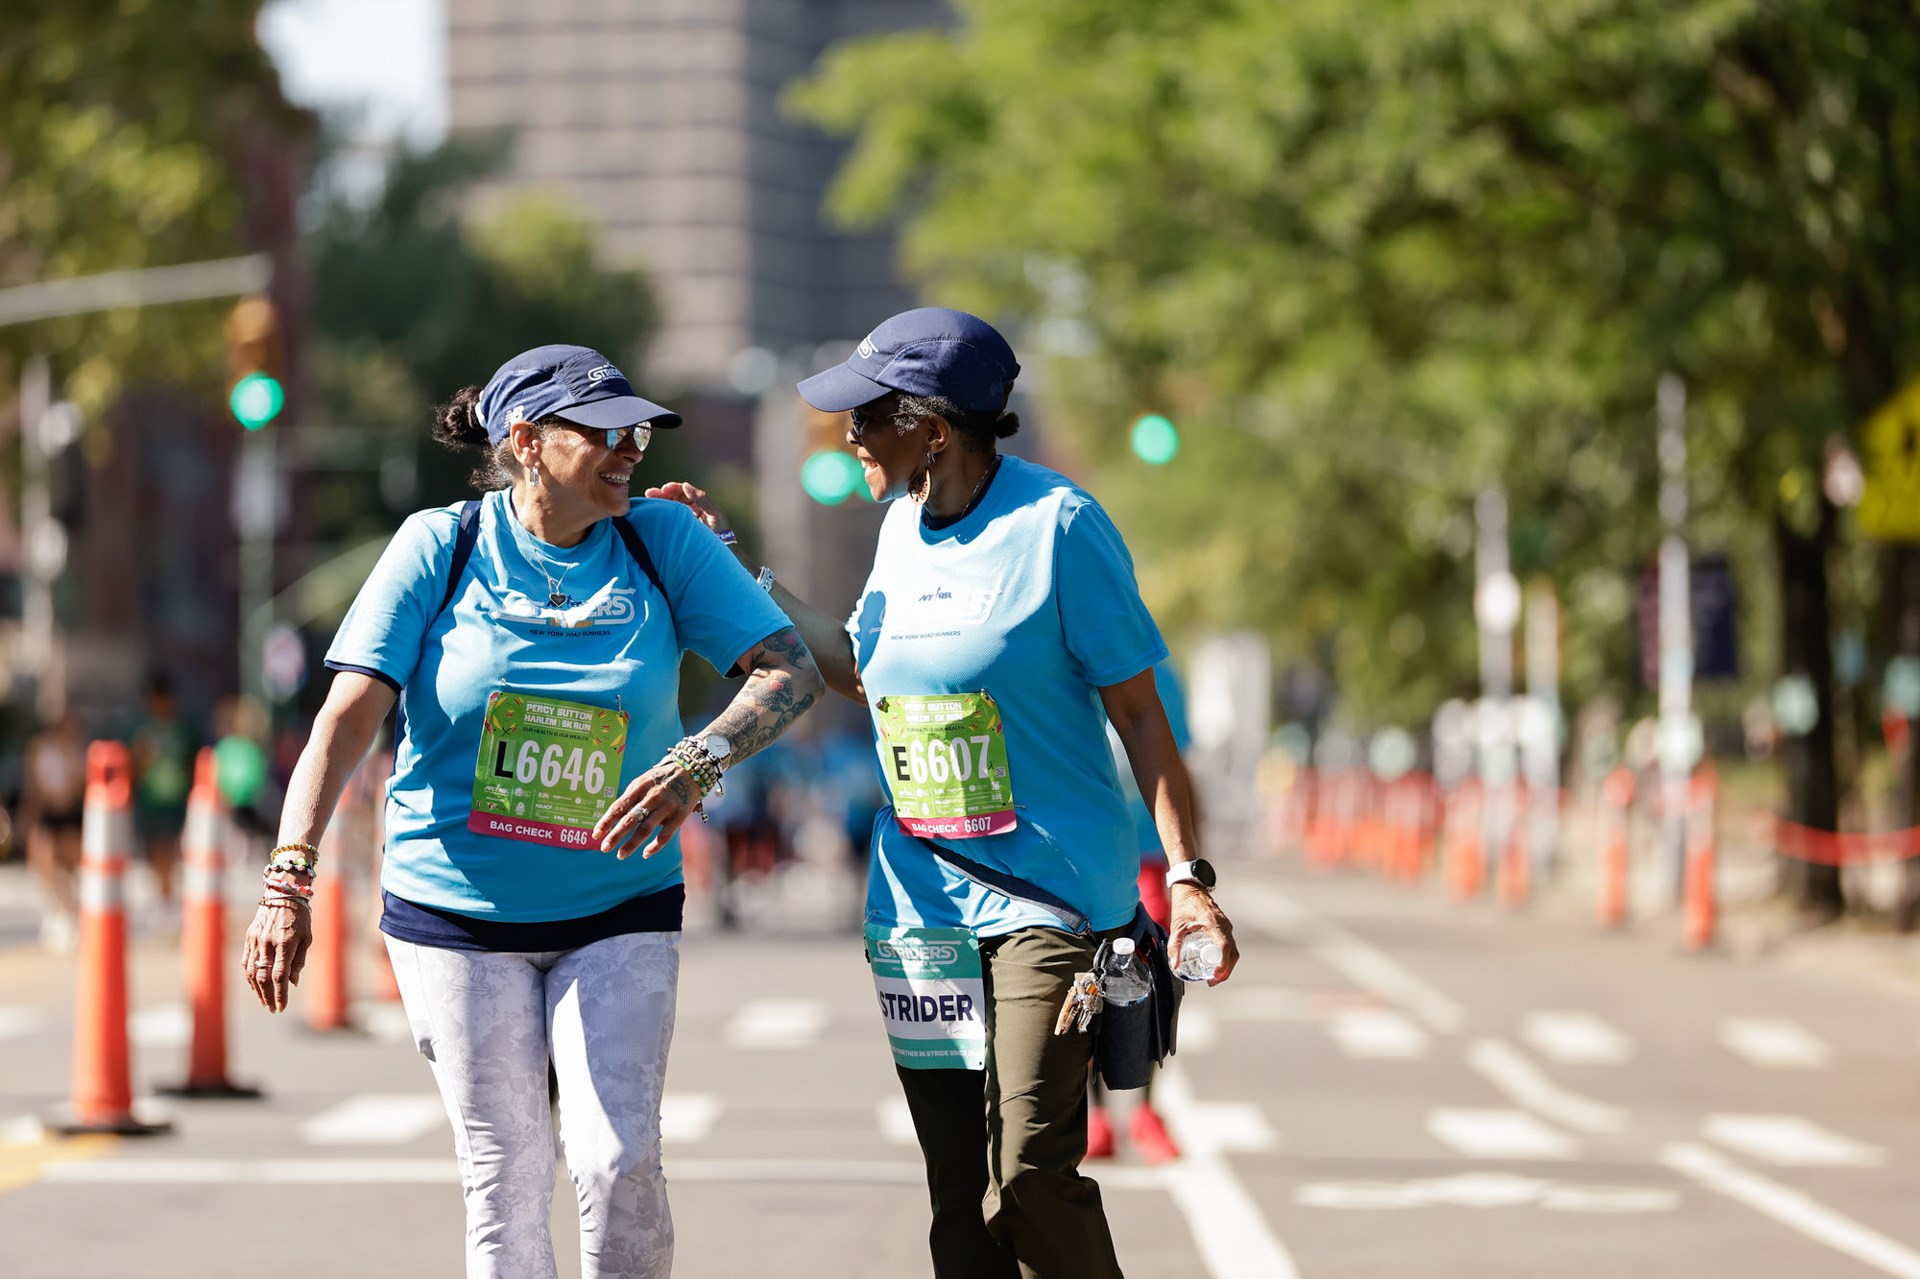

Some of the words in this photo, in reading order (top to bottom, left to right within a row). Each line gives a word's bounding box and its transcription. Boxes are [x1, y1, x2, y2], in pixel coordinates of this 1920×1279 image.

[526, 703, 555, 715] PERCY
[557, 707, 593, 720] SUTTON
[524, 714, 557, 726] HARLEM
[561, 719, 573, 729] 5K
[573, 721, 591, 732] RUN
[489, 820, 513, 833] BAG
[515, 825, 553, 839] CHECK
[560, 828, 588, 845] 6646
[911, 823, 927, 833] BAG
[927, 823, 959, 833] CHECK
[963, 816, 992, 833] 6607
[878, 943, 957, 961] STRIDERS
[880, 991, 974, 1022] STRIDER
